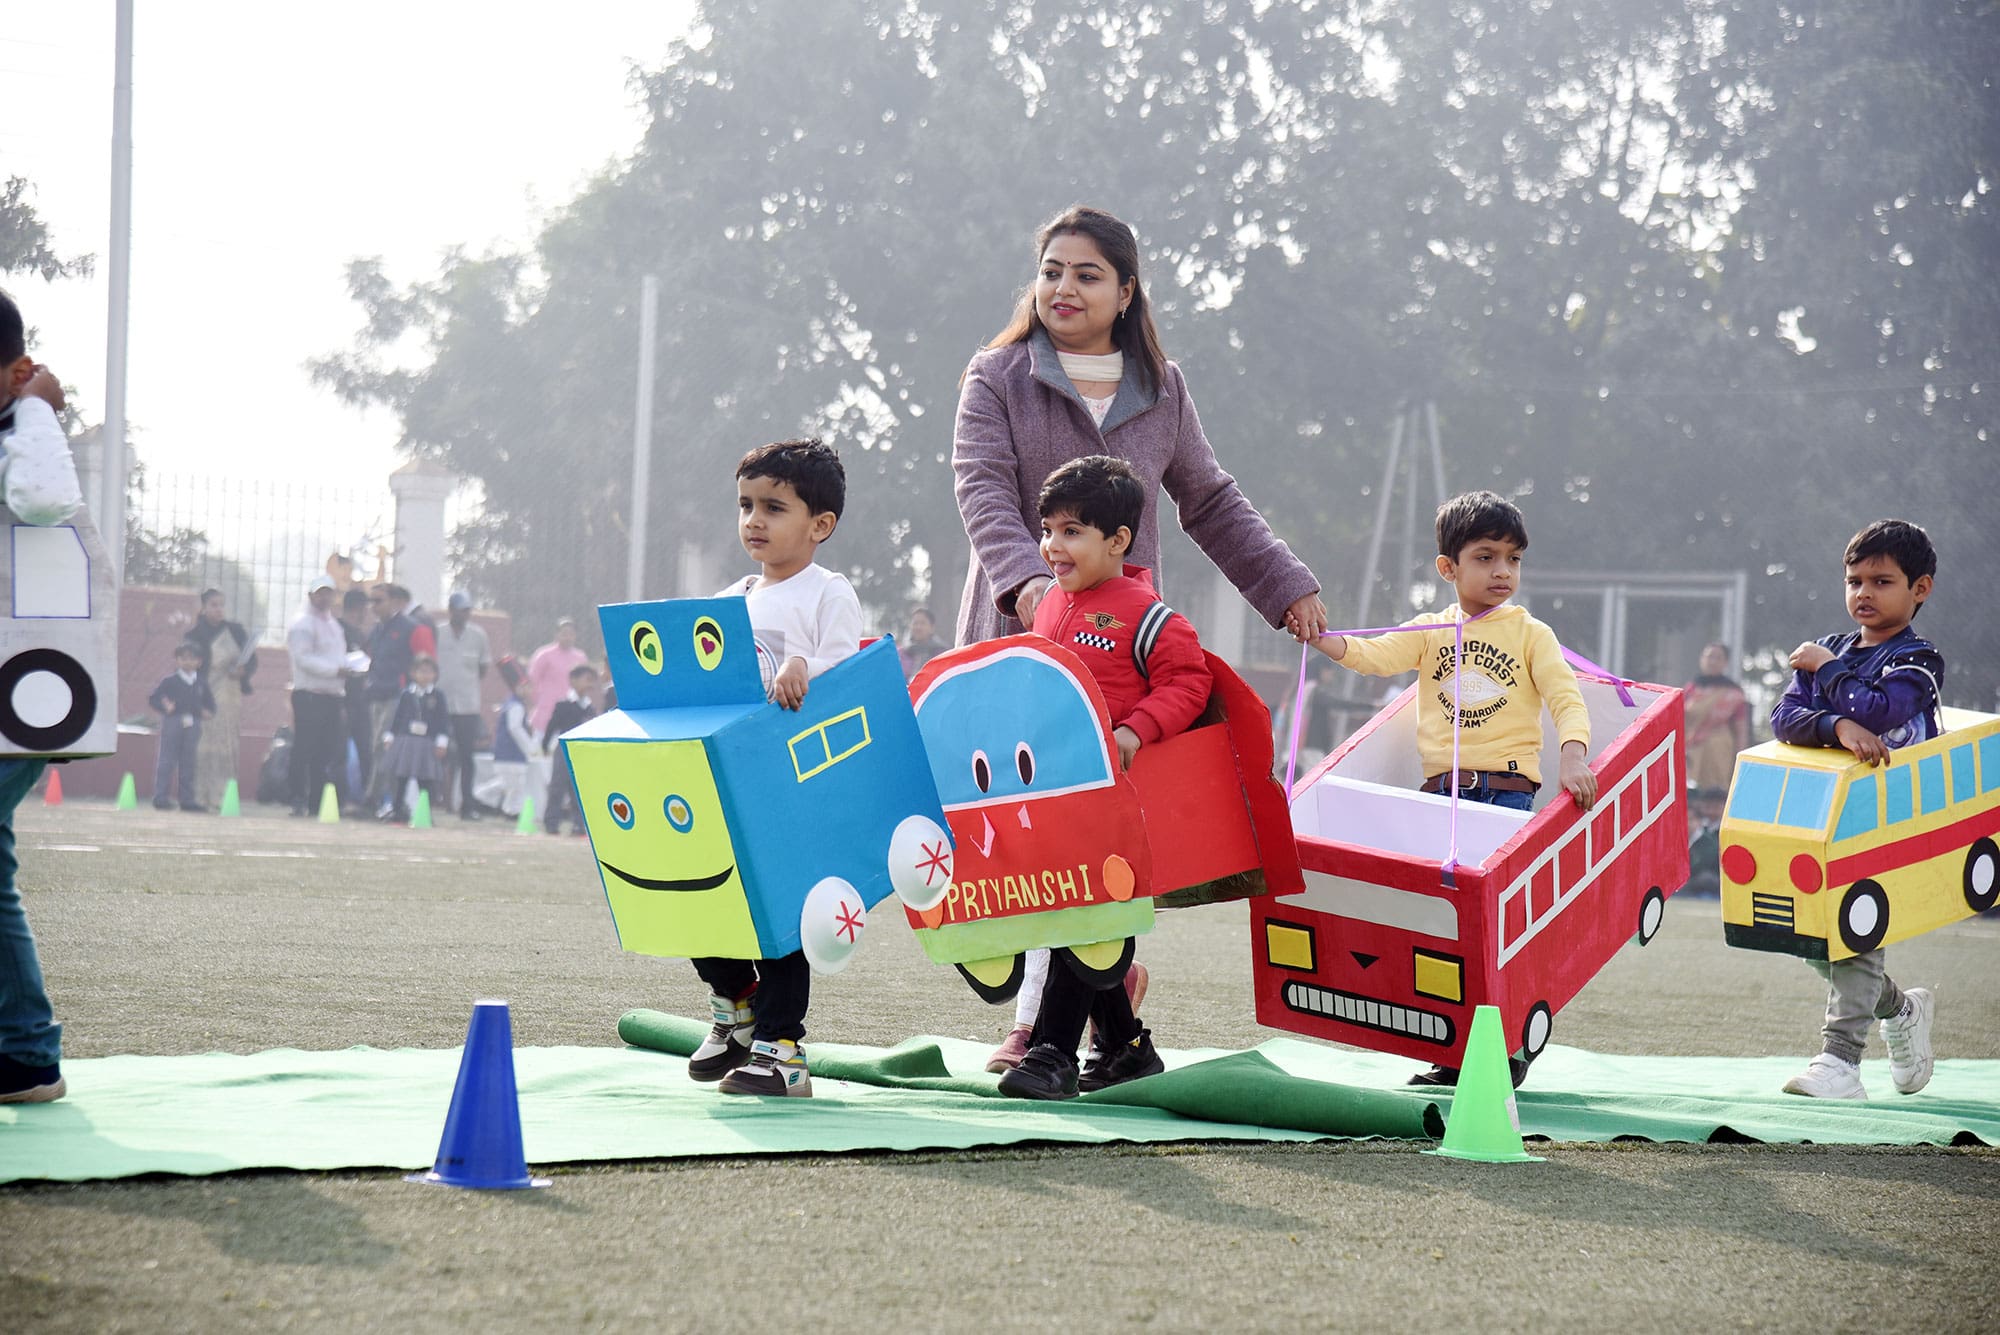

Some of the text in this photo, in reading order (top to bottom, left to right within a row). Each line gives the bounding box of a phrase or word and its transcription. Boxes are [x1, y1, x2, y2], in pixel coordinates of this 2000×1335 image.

[1432, 654, 1518, 687] WEST COAST
[1437, 692, 1508, 719] SKATBOARDING
[946, 864, 1094, 921] PRIYANSHI
